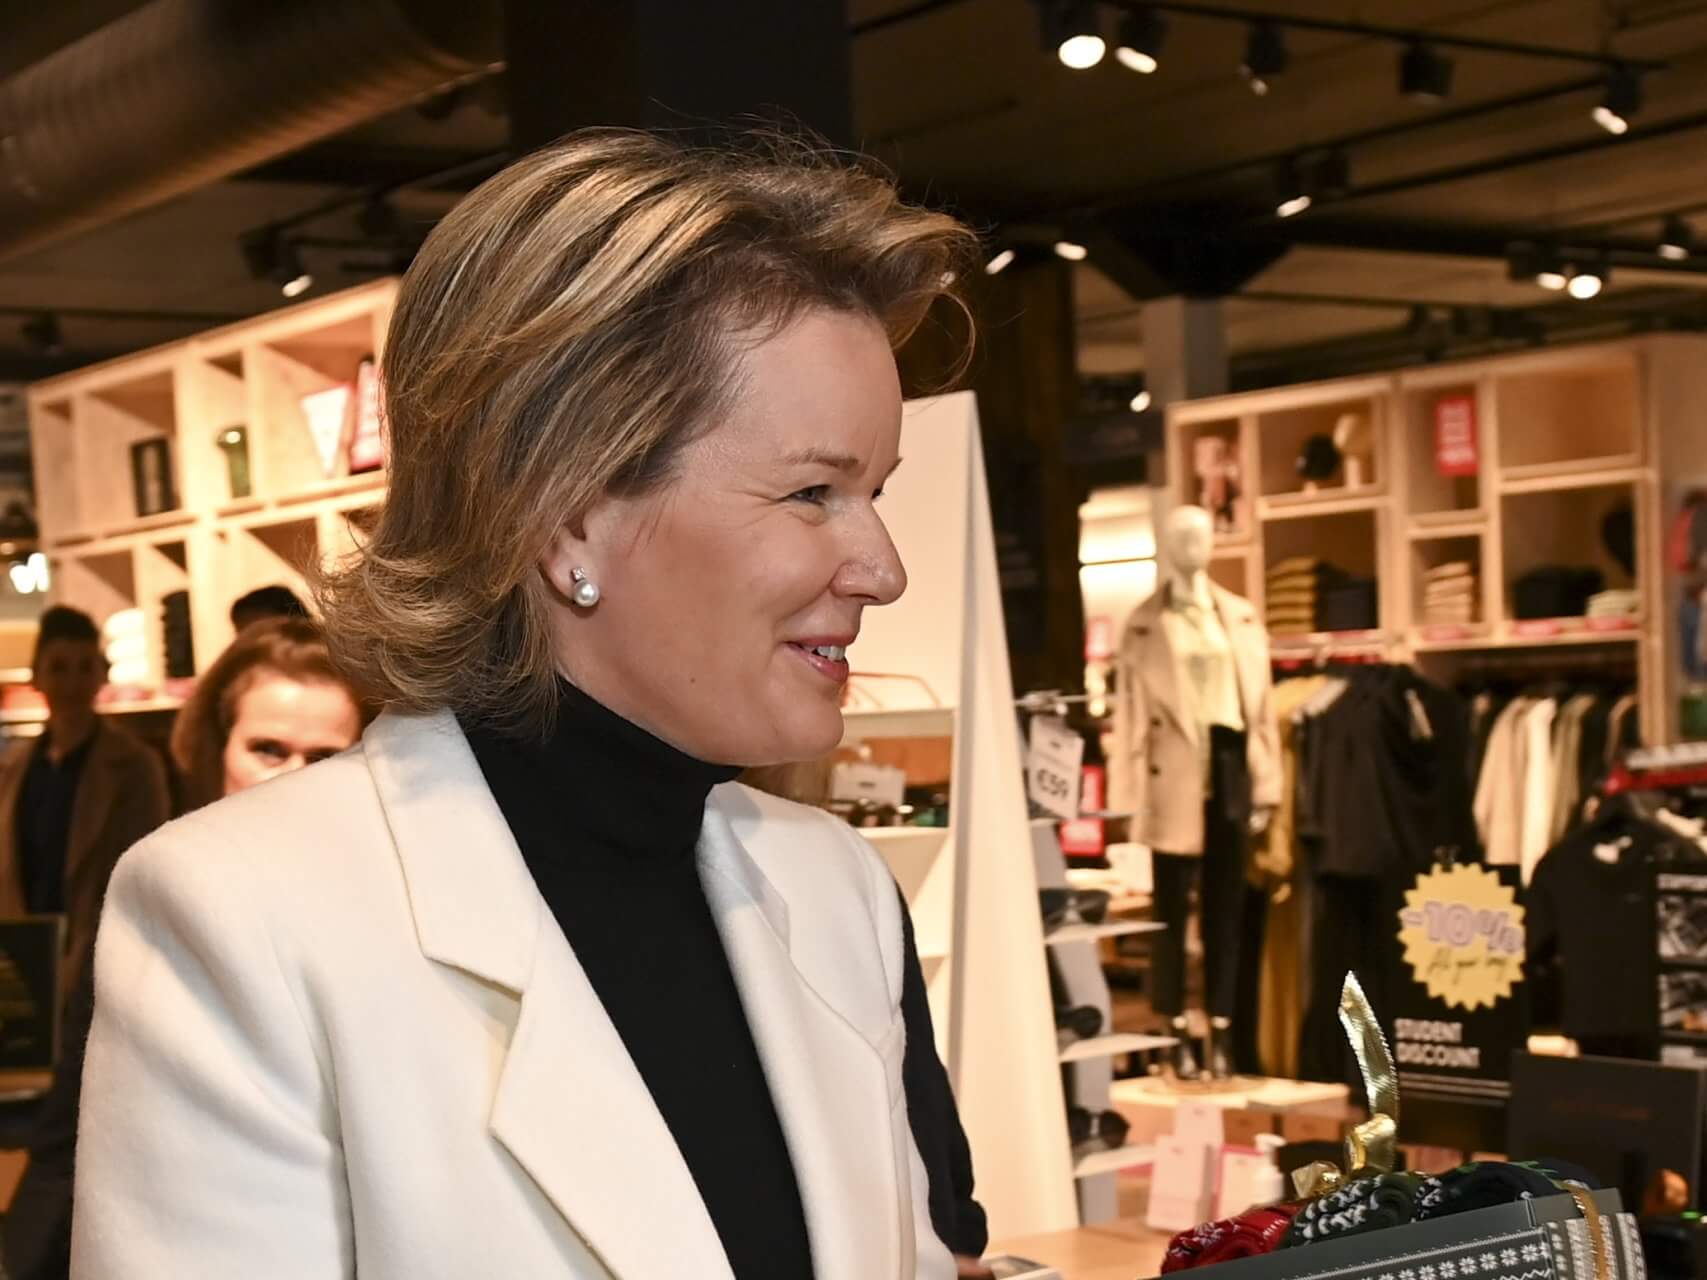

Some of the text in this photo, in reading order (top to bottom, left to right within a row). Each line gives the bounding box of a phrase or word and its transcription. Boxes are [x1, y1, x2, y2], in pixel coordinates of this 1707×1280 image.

[1403, 900, 1525, 956] -10%
[1394, 1017, 1463, 1043] STUDENT
[1395, 1041, 1480, 1069] DISCOUNT
